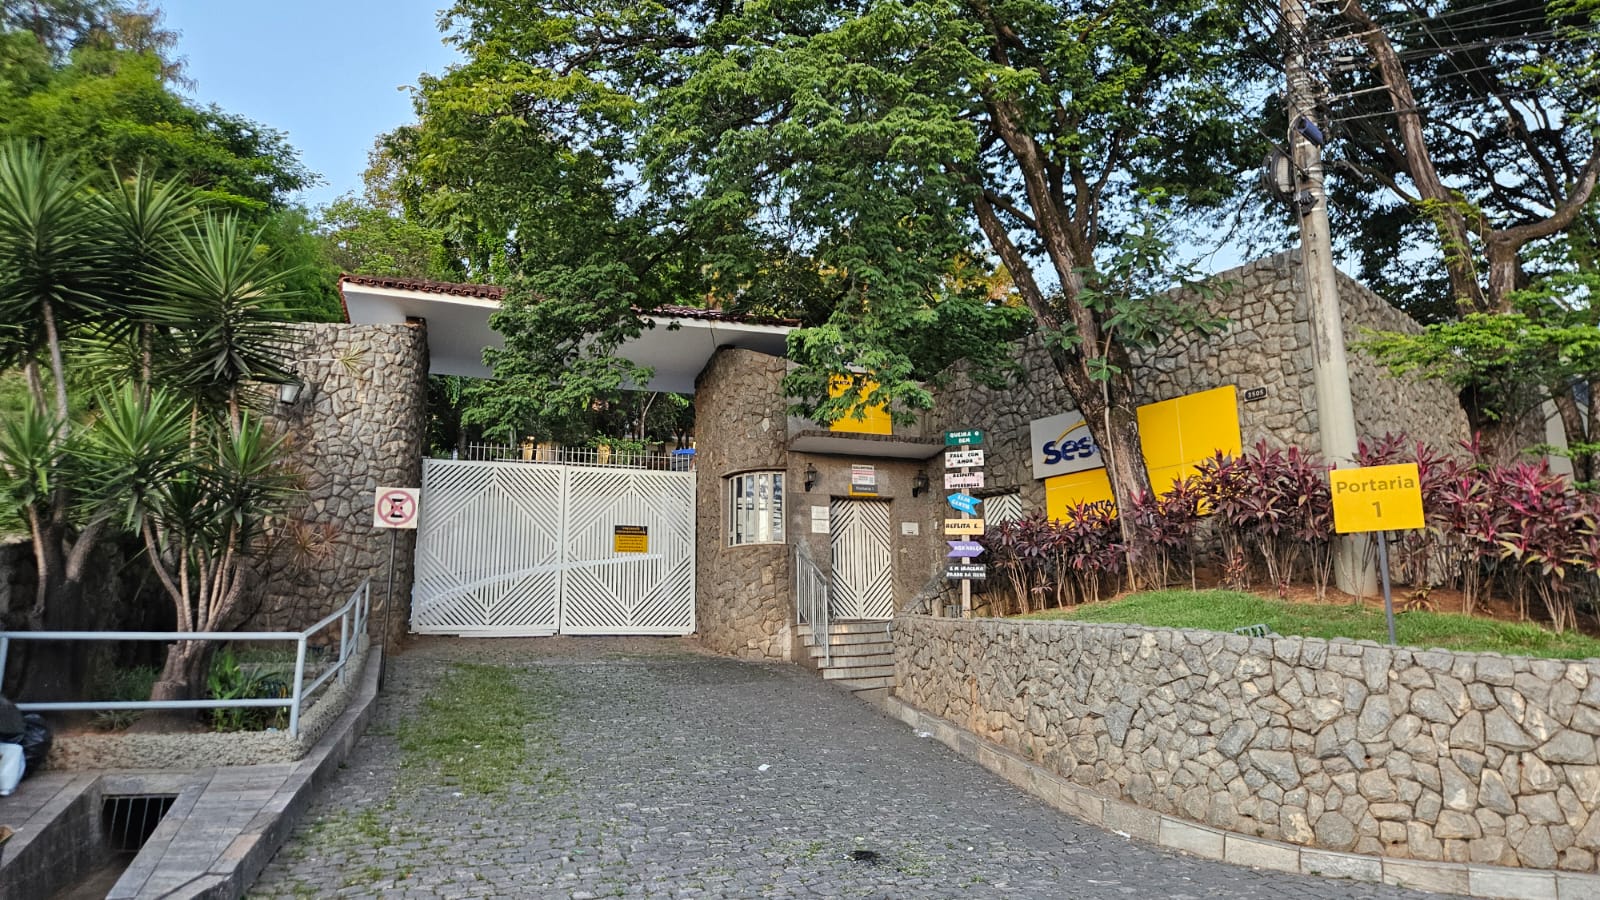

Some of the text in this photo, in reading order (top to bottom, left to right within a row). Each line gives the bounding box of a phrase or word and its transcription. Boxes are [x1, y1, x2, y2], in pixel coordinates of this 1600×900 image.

[1042, 436, 1096, 465] Ses
[1336, 476, 1415, 494] Portaria
[1372, 501, 1382, 518] 1
